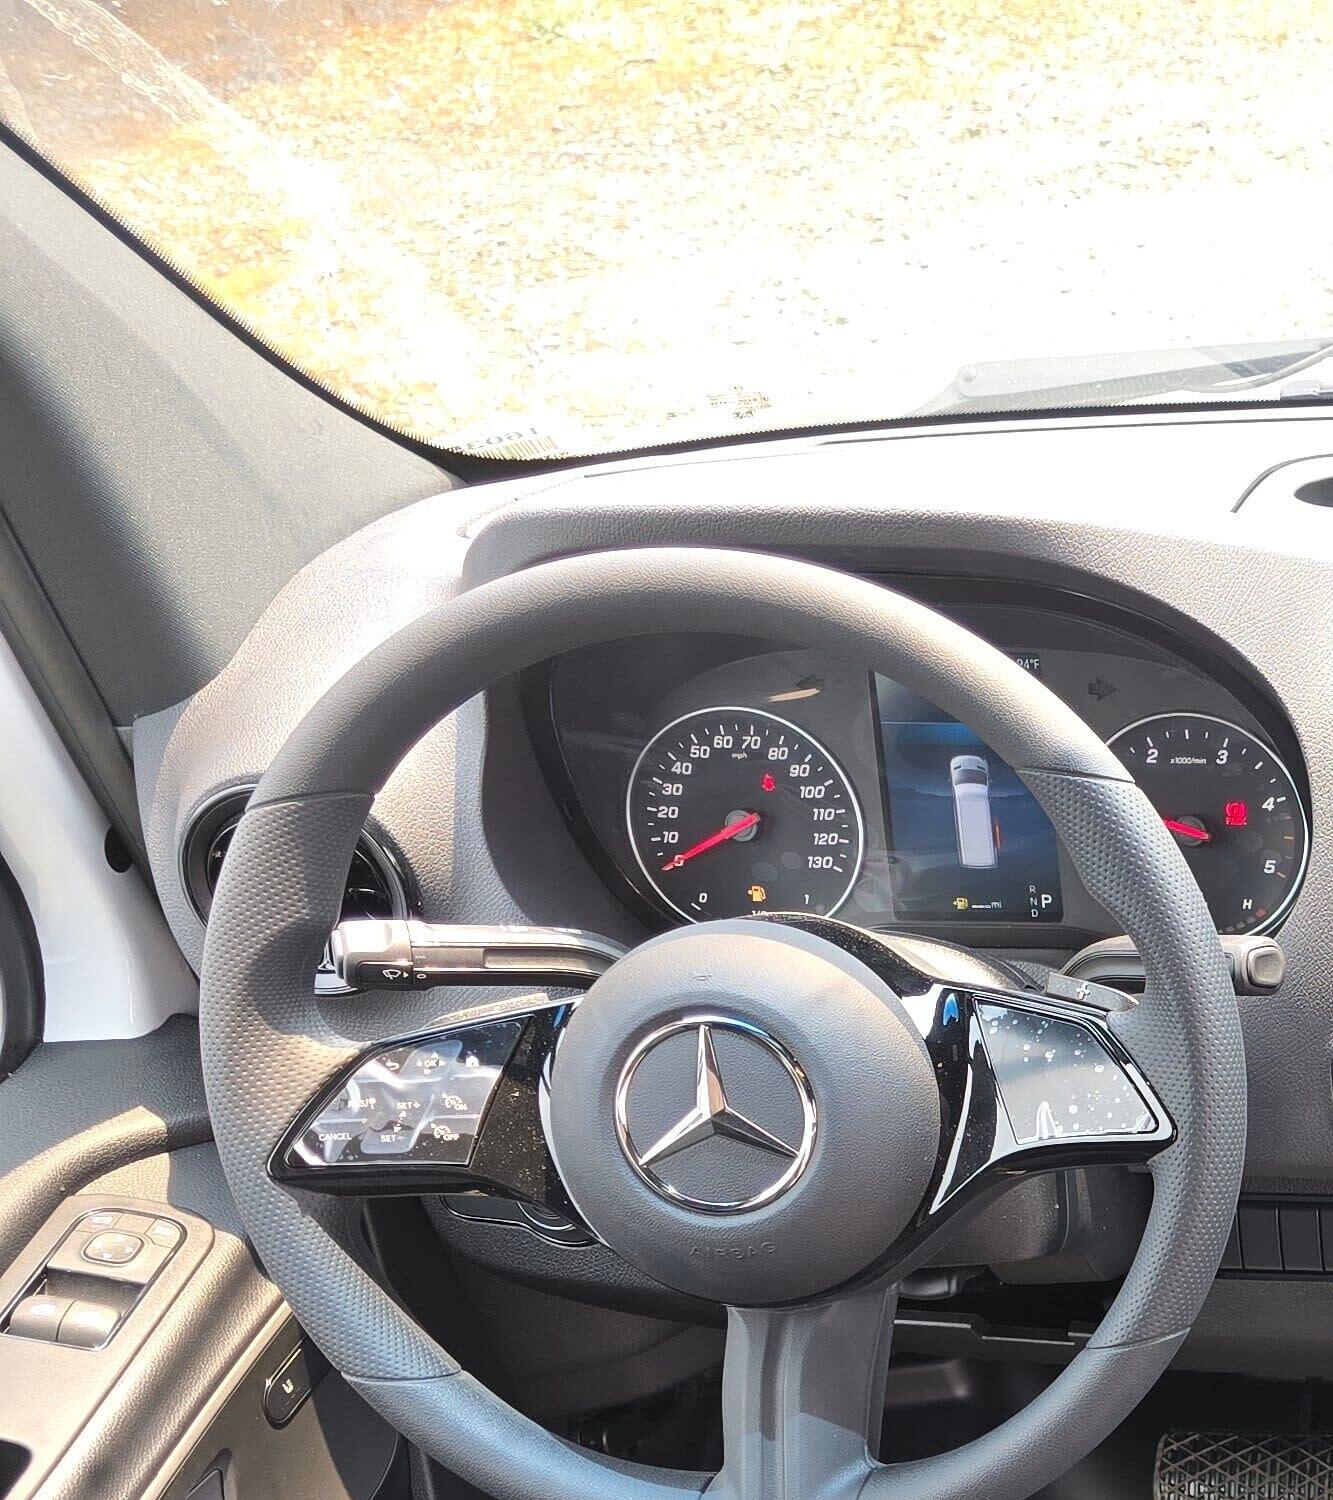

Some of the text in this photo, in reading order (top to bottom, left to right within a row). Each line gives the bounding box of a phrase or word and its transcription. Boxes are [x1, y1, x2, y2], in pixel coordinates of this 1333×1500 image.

[713, 735, 733, 749] 60
[741, 735, 761, 749] 70
[690, 746, 710, 759] 50
[732, 752, 747, 760] mph
[768, 747, 788, 760] 80
[1146, 748, 1158, 764] 2
[1216, 750, 1228, 765] 3
[671, 762, 692, 775] 40
[789, 764, 810, 777] 90
[662, 783, 683, 796] 30
[800, 785, 825, 799] 100
[1262, 797, 1275, 812] 4
[657, 806, 679, 818] 20
[813, 808, 835, 821] 110
[663, 831, 679, 843] 10
[813, 833, 839, 845] 120
[808, 856, 833, 869] 130
[1263, 859, 1276, 874] 5
[1029, 884, 1037, 894] R
[699, 893, 708, 904] 0
[804, 894, 810, 905] 1
[1030, 894, 1053, 909] N P
[1242, 899, 1252, 910] H
[1031, 909, 1039, 918] D
[318, 1132, 353, 1142] CANCEL
